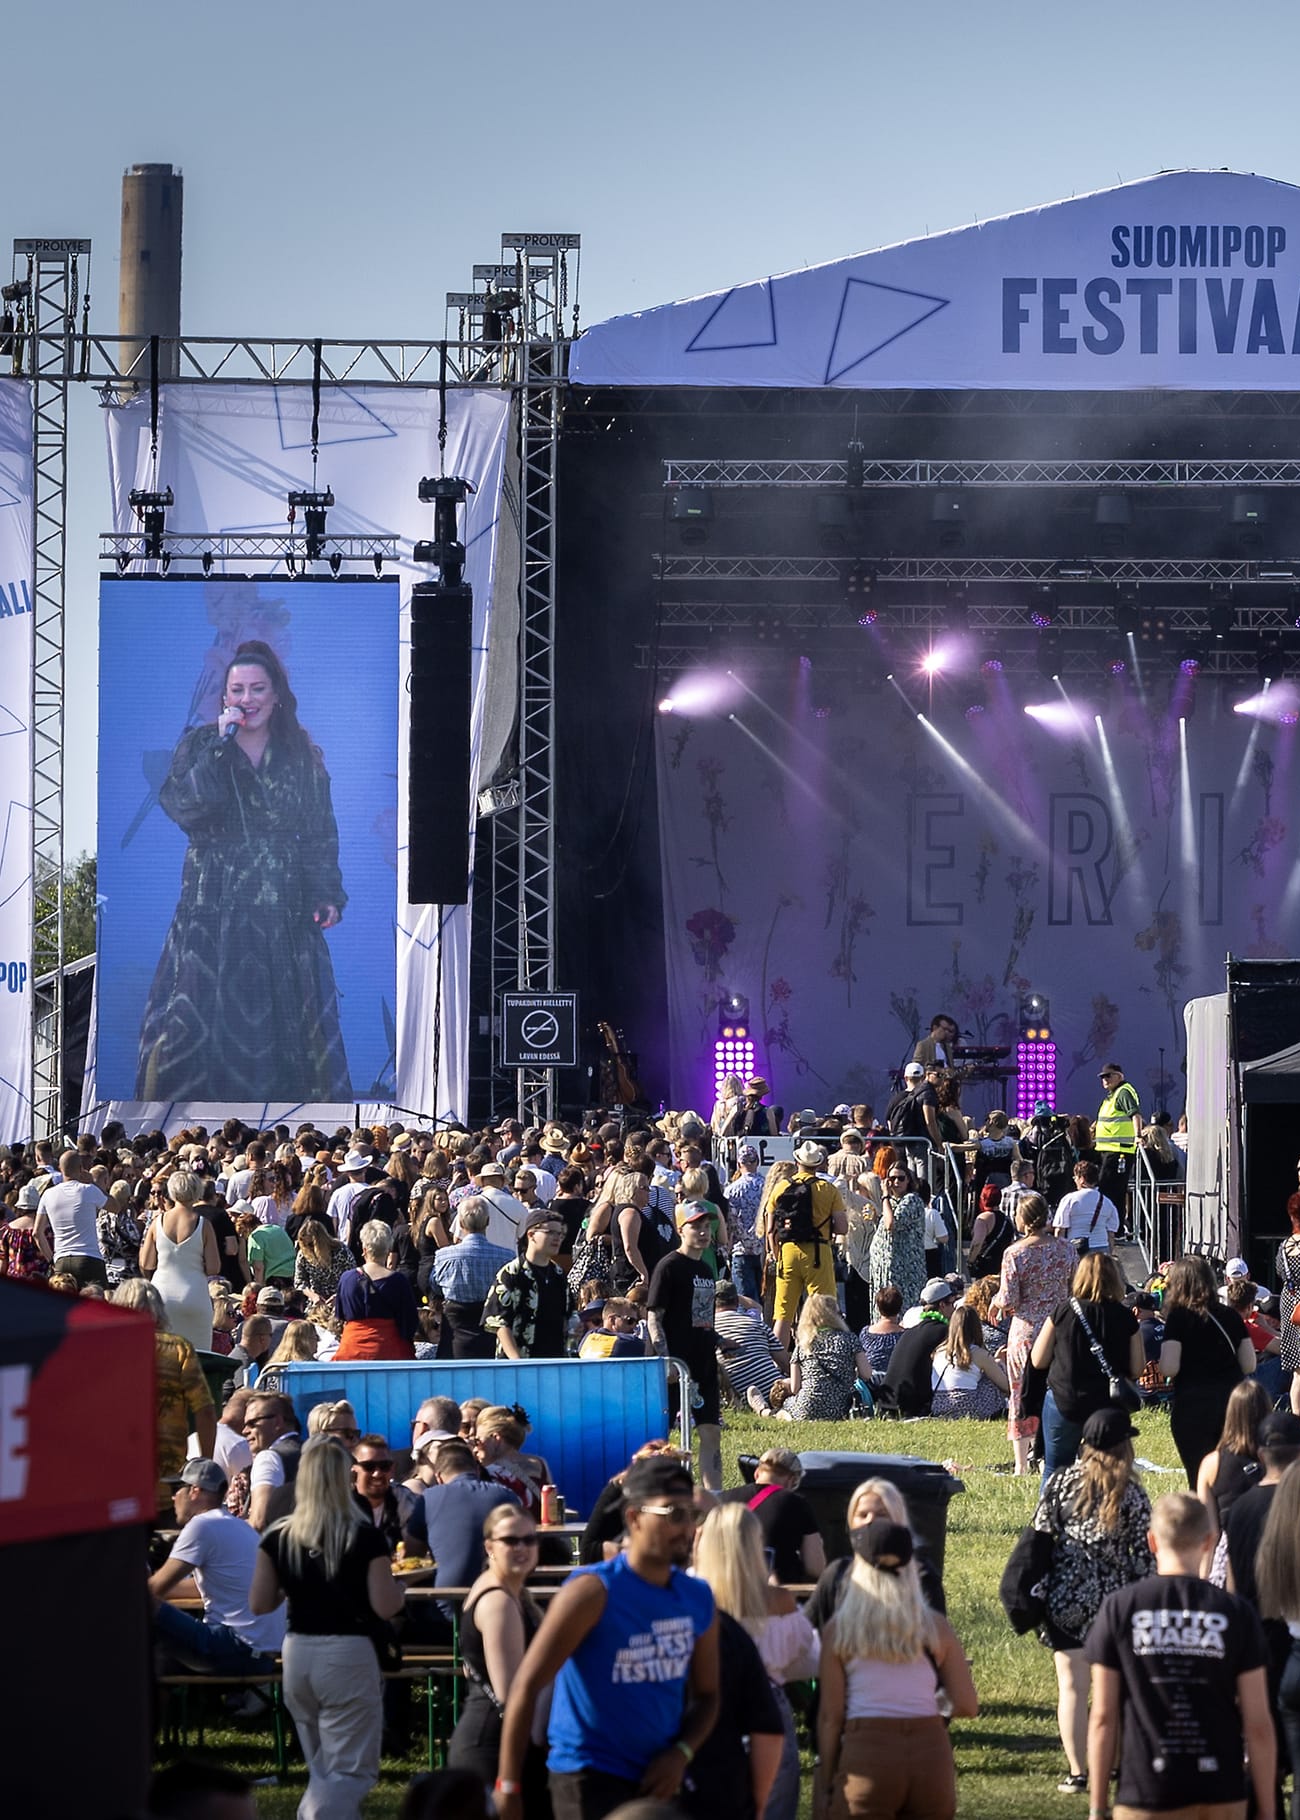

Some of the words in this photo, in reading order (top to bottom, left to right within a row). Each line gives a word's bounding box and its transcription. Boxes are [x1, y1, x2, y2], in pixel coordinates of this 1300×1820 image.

[35, 240, 84, 252] PROLYTE
[524, 235, 573, 246] PROLYTE
[1111, 225, 1286, 268] SUOMIPOP
[507, 999, 542, 1007] TUPAKOINTI
[543, 999, 573, 1007] KIELLETTY
[519, 1052, 538, 1060] LAVAN
[539, 1051, 560, 1060] EDESSÄ
[1132, 1628, 1226, 1648] MASA
